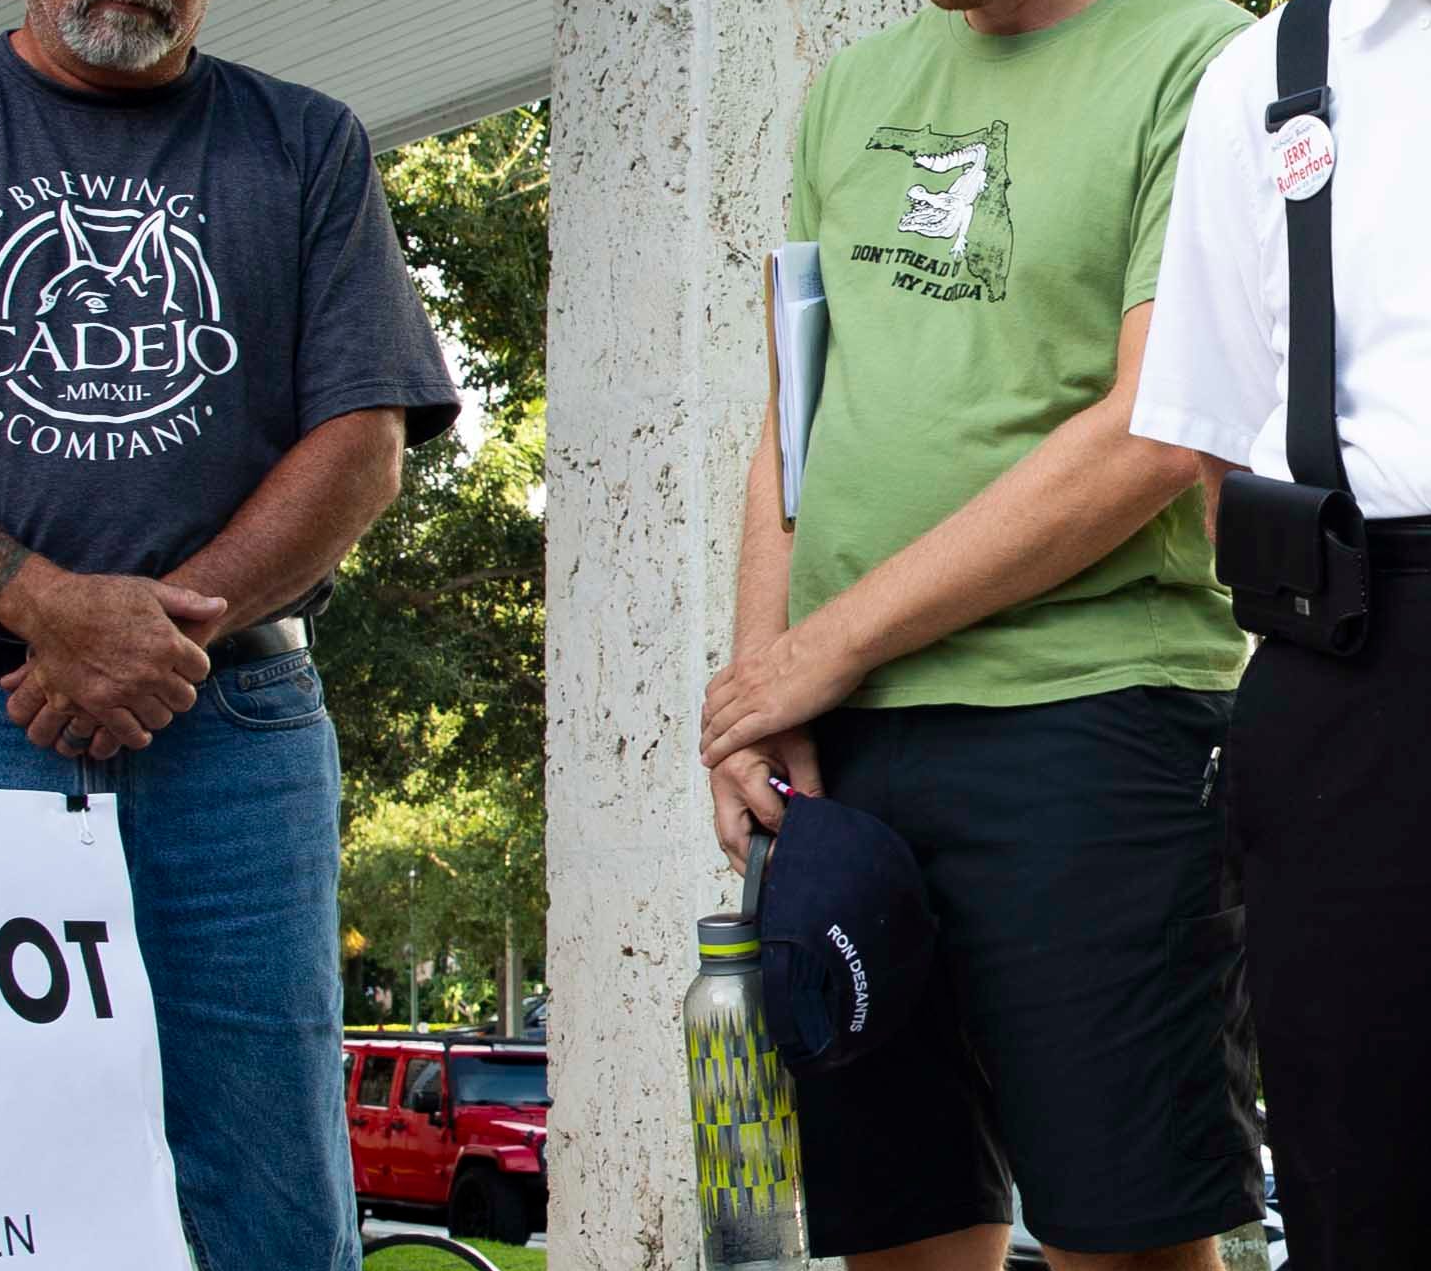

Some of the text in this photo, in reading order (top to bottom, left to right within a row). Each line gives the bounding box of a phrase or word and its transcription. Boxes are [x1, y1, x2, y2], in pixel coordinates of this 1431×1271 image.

[1283, 137, 1311, 168] JERRY
[8, 171, 194, 219] BREWING
[891, 271, 923, 291] MY
[7, 405, 202, 460] COMPANY
[827, 924, 868, 1032] RON DESANTIS
